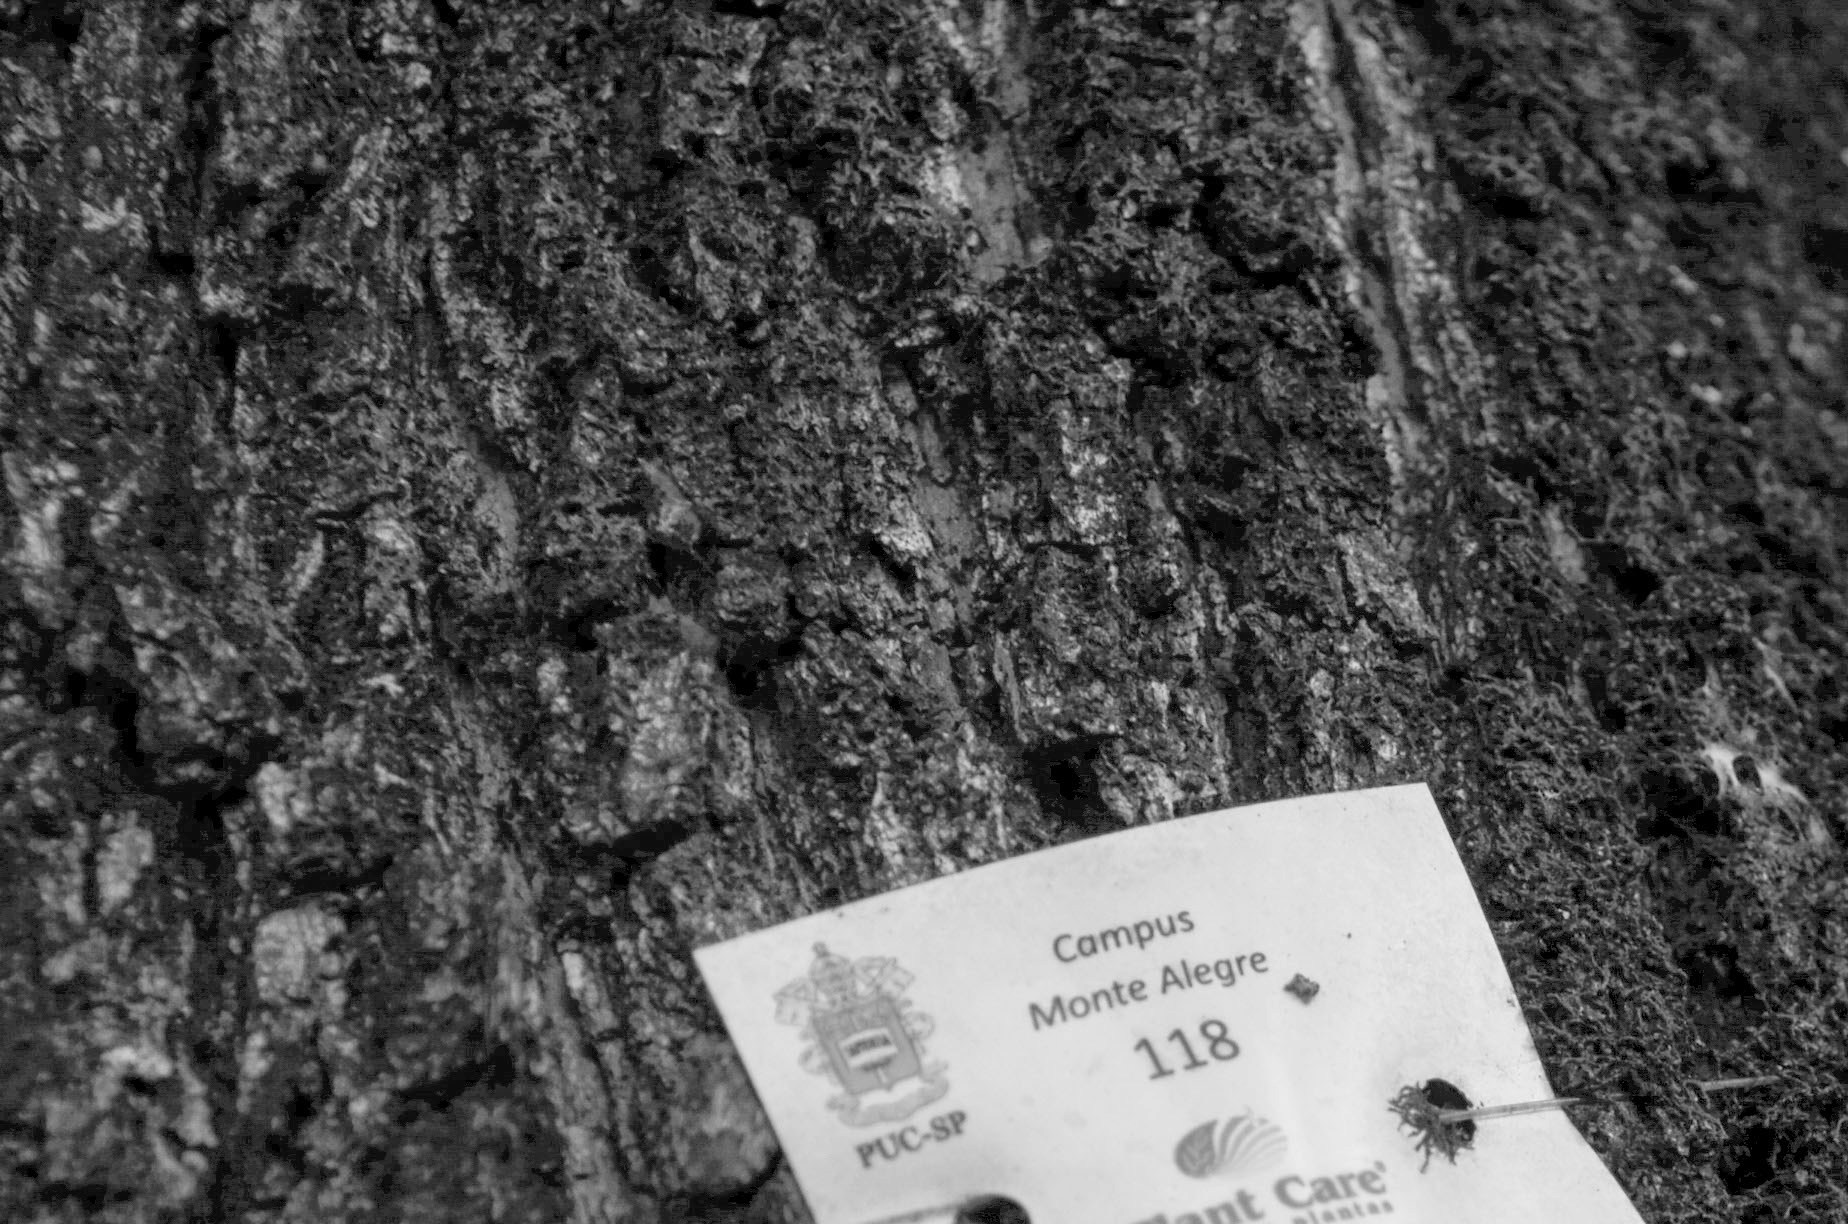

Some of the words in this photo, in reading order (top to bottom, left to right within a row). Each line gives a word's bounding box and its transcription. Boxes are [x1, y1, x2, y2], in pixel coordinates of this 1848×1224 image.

[1052, 908, 1195, 963] Campus
[1028, 976, 1148, 1031] Monte
[1160, 949, 1269, 995] Alegre
[1133, 1018, 1241, 1081] 118
[855, 1110, 968, 1168] PUC-SP
